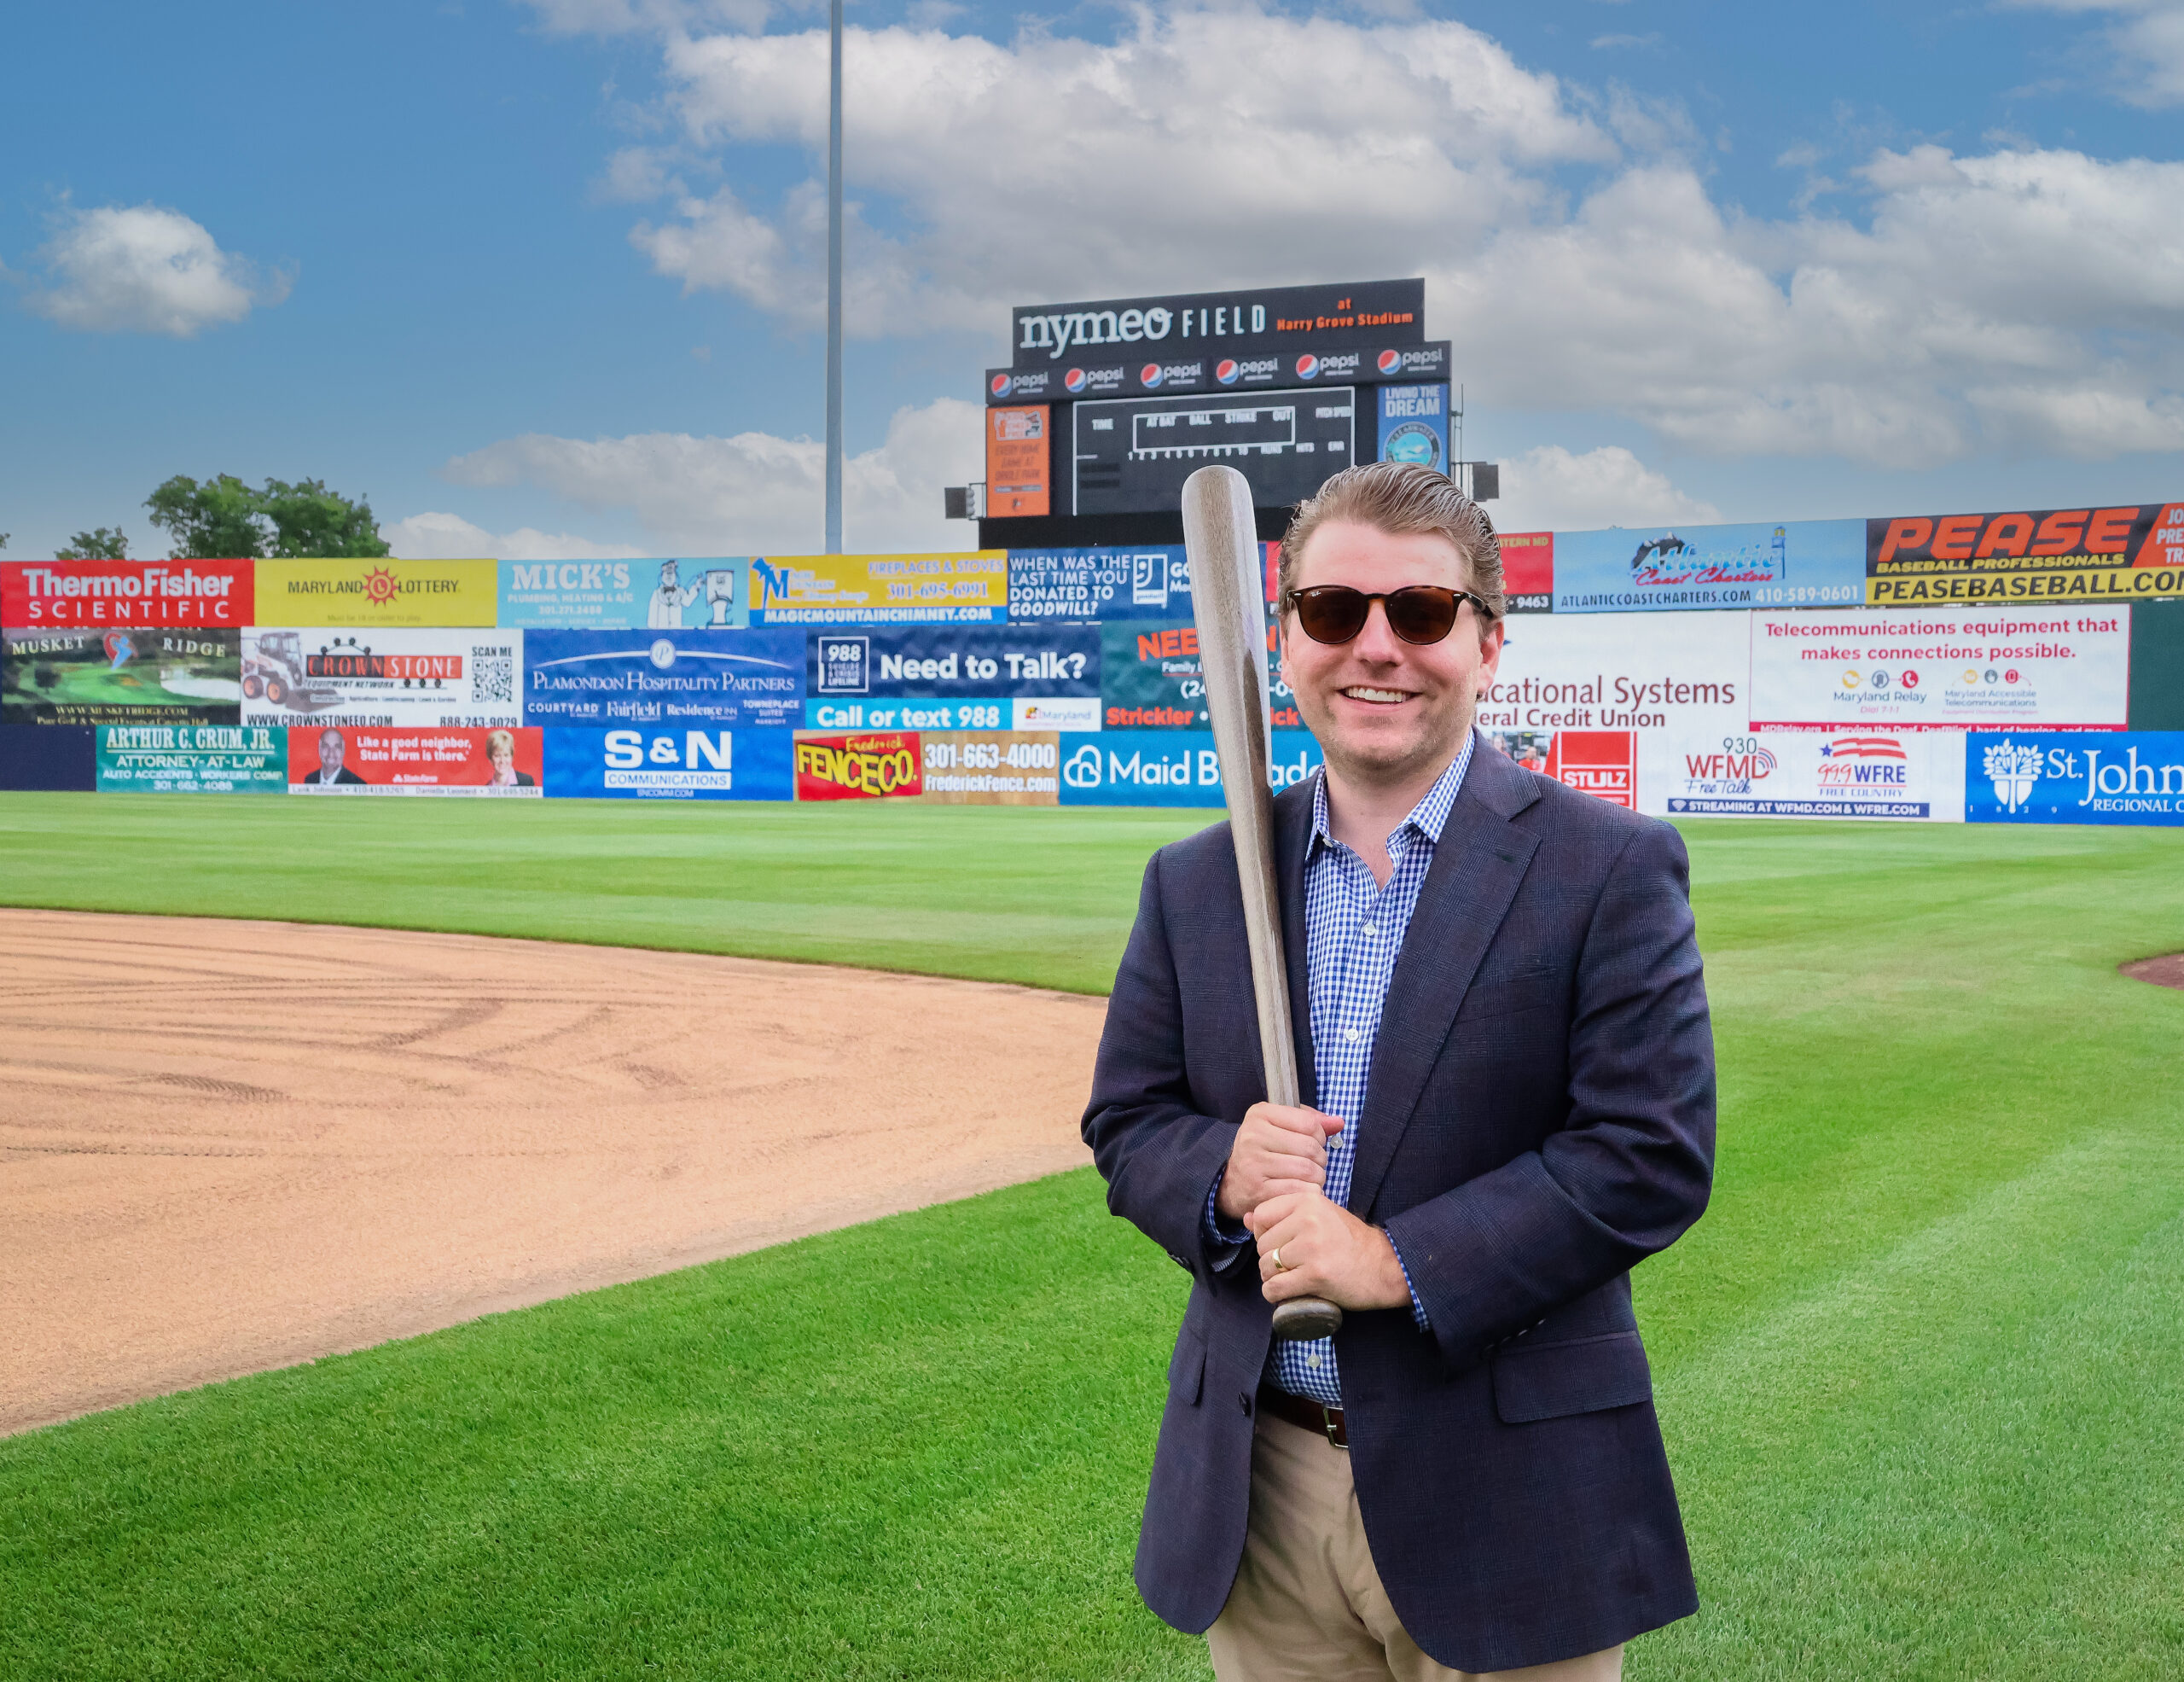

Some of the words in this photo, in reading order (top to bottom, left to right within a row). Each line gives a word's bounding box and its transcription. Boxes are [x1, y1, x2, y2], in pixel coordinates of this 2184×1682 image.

[1337, 298, 1352, 310] at
[1277, 317, 1313, 331] Harry
[1316, 315, 1354, 329] Grove
[1357, 311, 1414, 326] Stadium
[1019, 307, 1173, 358] nymeo
[1182, 305, 1265, 338] FIELD
[1320, 352, 1359, 370] pepsi
[1402, 348, 1442, 365] pepsi
[1087, 367, 1124, 383] pepsi
[1163, 363, 1201, 380] pepsi
[1239, 358, 1278, 375] pepsi
[1013, 371, 1048, 388] pepsi
[1420, 385, 1440, 398] THE
[1385, 398, 1440, 417] DREAM
[1533, 537, 1549, 547] MD
[1878, 508, 2140, 562] PEASE
[868, 561, 940, 573] FIREPLACES
[943, 560, 953, 573] &
[956, 559, 1004, 573] STOVES
[1009, 556, 1058, 571] WHEN
[1063, 556, 1096, 570] WAS
[1100, 555, 1130, 569] THE
[1641, 543, 1779, 572] Atlantic
[1876, 559, 1969, 573] BASEBALL
[1972, 554, 2125, 570] PROFESSIONALS
[512, 563, 630, 590] MICK'S
[1009, 572, 1047, 586] LAST
[1051, 570, 1089, 585] TIME
[1092, 570, 1128, 585] YOU
[1636, 568, 1692, 586] Coast
[1695, 566, 1774, 585] Charters
[288, 581, 363, 594] MARYLAND
[887, 580, 989, 600] 301-695-6991
[1009, 585, 1089, 602] DONATED
[1092, 585, 1114, 600] TO
[562, 593, 604, 602] HEATING
[616, 591, 634, 603] A/C
[29, 601, 229, 619] SCIENTIFIC
[764, 608, 993, 624] MAGICMOUNTAINCHIMNEY.COM
[1009, 601, 1099, 617] GOODWILL?
[1765, 620, 1956, 637] Telecommunications
[1963, 618, 2071, 637] equipment
[2077, 618, 2118, 633] that
[12, 635, 84, 655] MUSKET
[163, 637, 226, 657] RIDGE
[472, 647, 495, 657] SCAN
[499, 647, 513, 657] ME
[828, 644, 862, 662] 988
[1801, 646, 1861, 661] makes
[1867, 643, 1984, 660] connections
[1989, 643, 2077, 662] possible.
[880, 653, 958, 680] Need
[965, 655, 998, 679] to
[1003, 652, 1087, 679] Talk?
[1162, 661, 1195, 674] Family
[533, 671, 624, 690] PLAMONDON
[627, 671, 719, 690] HOSPITALITY
[722, 672, 795, 690] PARTNERS
[1615, 677, 1735, 712] Systems
[1833, 690, 1891, 704] Maryland
[1894, 690, 1927, 704] Relay
[1945, 689, 1986, 699] Maryland
[1988, 689, 2036, 698] Accessible
[528, 702, 598, 713] COURTYARD
[607, 701, 660, 718] Fairfield
[666, 702, 723, 716] Residence
[743, 700, 799, 710] TOWNEPLACE
[1945, 699, 2036, 707] Telecommunications
[816, 705, 863, 728] Call
[868, 710, 895, 727] or
[901, 707, 951, 727] text
[958, 706, 1000, 727] 988
[1043, 710, 1092, 721] Maryland
[1106, 707, 1194, 725] Strickler
[1526, 708, 1592, 726] Credit
[1601, 709, 1665, 726] Union
[106, 728, 176, 748] ARTHUR
[177, 728, 193, 748] C.
[195, 728, 247, 750] CRUM,
[250, 729, 276, 749] JR.
[357, 736, 380, 748] Like
[382, 739, 389, 748] a
[392, 736, 418, 751] good
[421, 736, 472, 750] neighbor,
[1723, 737, 1757, 754] 930
[116, 754, 266, 769] ATTORNEY-AT-LAW
[360, 749, 389, 761] State
[392, 749, 420, 761] Farm
[422, 749, 432, 761] is
[924, 742, 1056, 769] 301-663-4000
[2046, 748, 2083, 779] St.
[102, 770, 132, 779] AUTO
[134, 770, 194, 780] ACCIDENTS
[200, 771, 251, 780] WORKERS
[1110, 750, 1191, 785] Maid
[1686, 754, 1770, 779] WFMD
[1854, 765, 1906, 783] WFRE
[608, 773, 727, 786] COMMUNICATIONS
[925, 774, 1057, 792] FrederickFence.com
[1564, 771, 1627, 788] STULZ
[1820, 788, 1846, 797] FREE
[1851, 788, 1904, 798] COUNTRY
[1689, 800, 1755, 812] STREAMING
[1757, 802, 1774, 812] AT
[1774, 803, 1844, 815] WFMD.COM
[1844, 805, 1852, 815] &
[1854, 804, 1920, 816] WFRE.COM
[2093, 799, 2173, 812] REGIONAL
